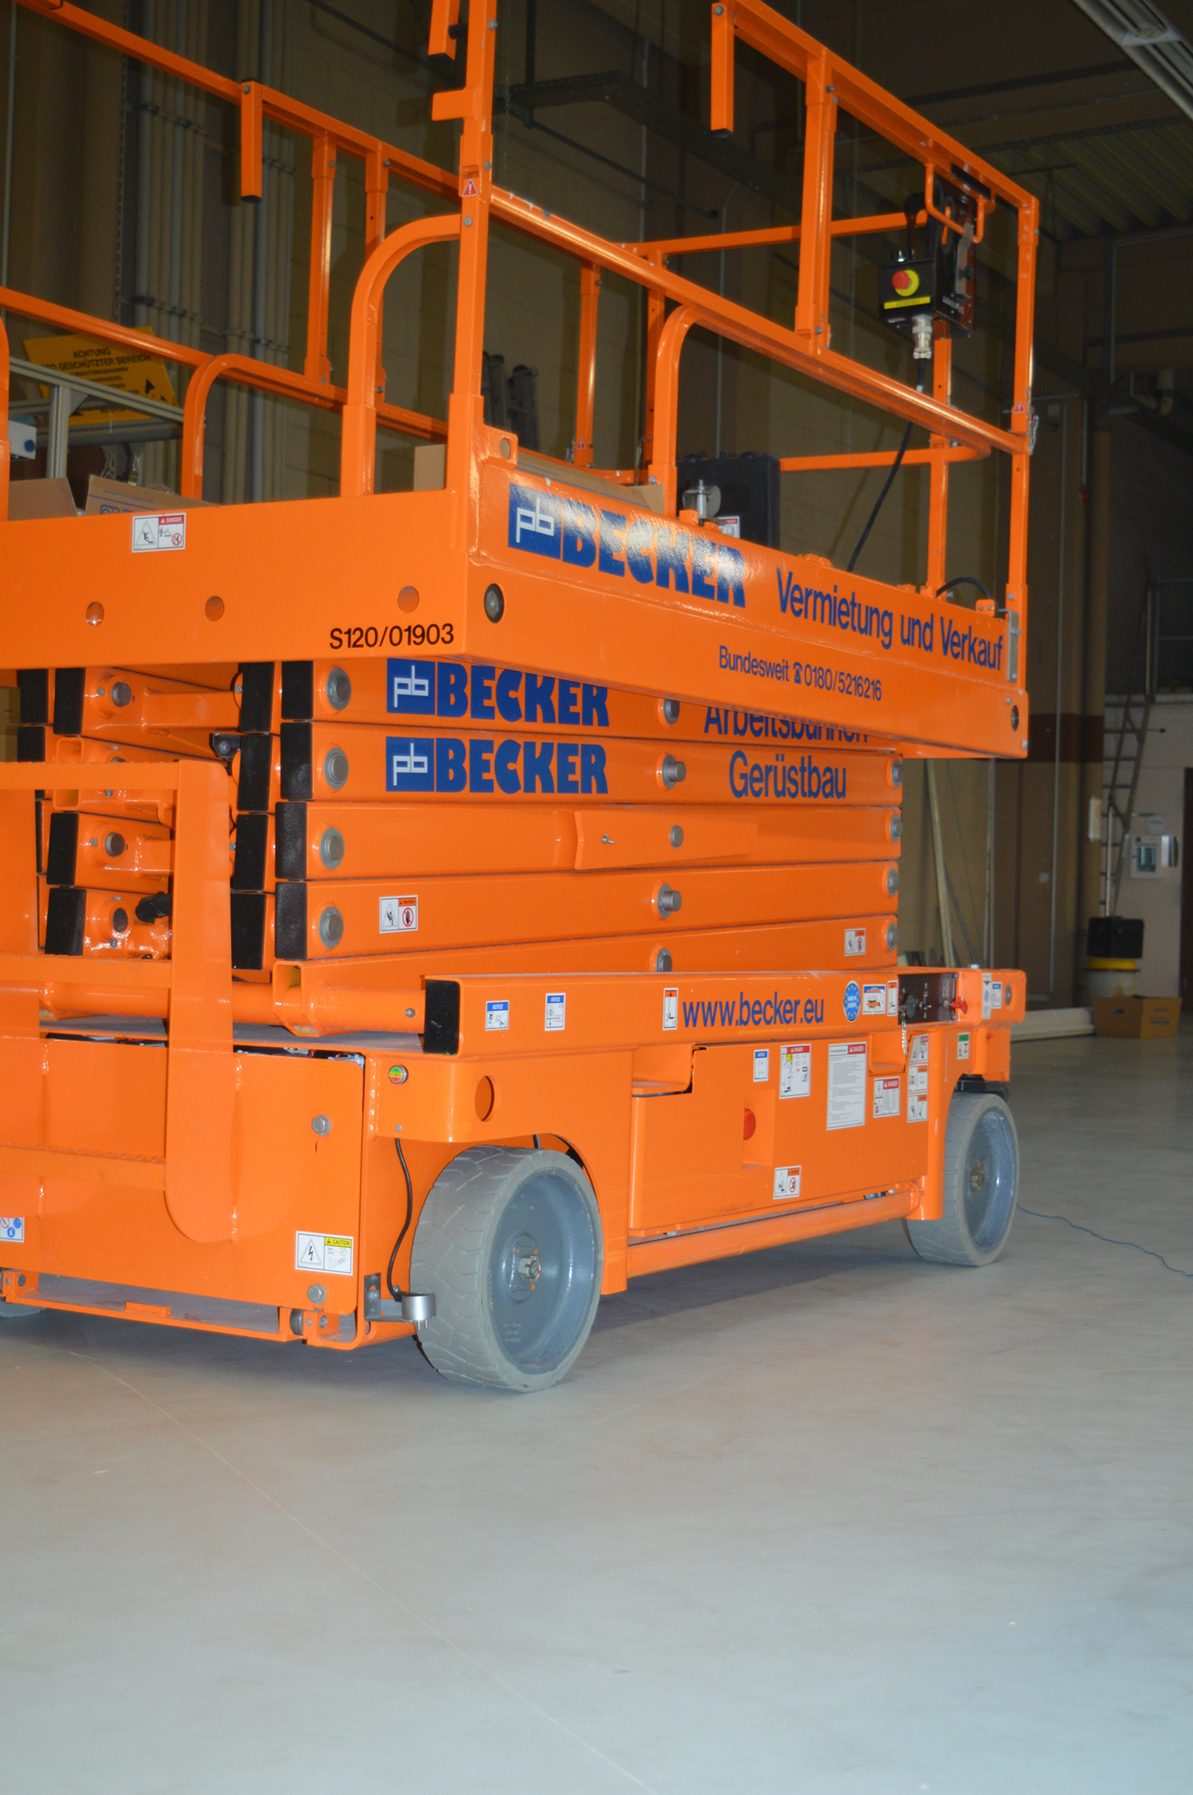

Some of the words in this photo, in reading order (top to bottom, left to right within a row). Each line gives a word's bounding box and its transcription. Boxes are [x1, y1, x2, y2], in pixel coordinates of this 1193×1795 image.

[562, 497, 746, 609] BECKER
[329, 623, 455, 650] S120/01903
[776, 567, 894, 650] Vermietung
[900, 613, 934, 653] und
[939, 615, 1004, 671] Verkauf
[436, 661, 610, 728] BECKER
[719, 644, 790, 683] Bundesweit
[804, 663, 883, 702] 0180/5216216
[435, 737, 609, 795] BECKER
[729, 750, 847, 799] Gerüstbau
[682, 991, 825, 1028] www.becker.eu
